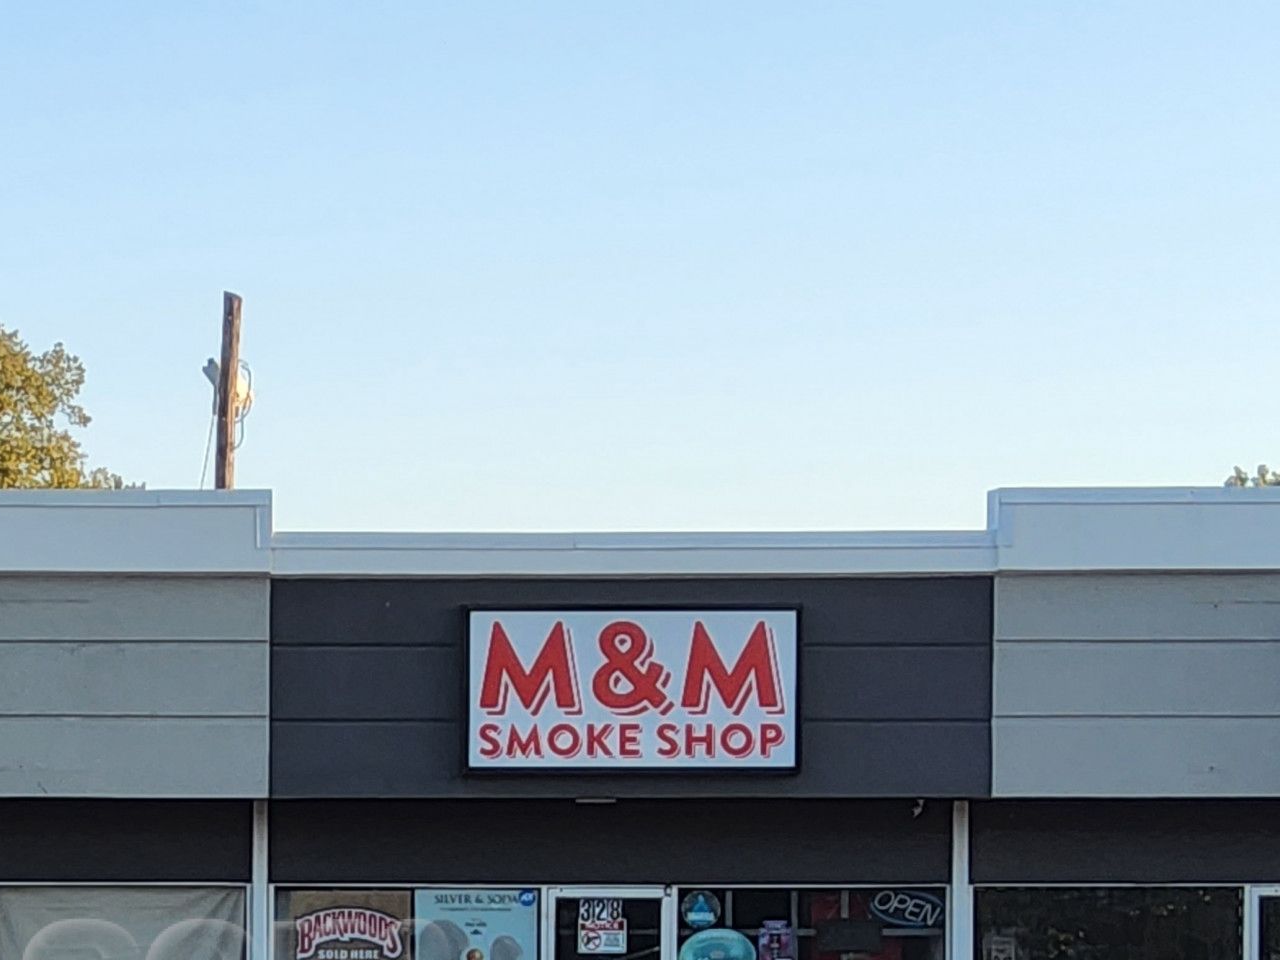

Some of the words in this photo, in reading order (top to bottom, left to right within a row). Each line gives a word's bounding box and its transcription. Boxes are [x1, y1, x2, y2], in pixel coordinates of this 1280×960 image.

[479, 620, 786, 716] M&M
[479, 722, 643, 758] SMOKE
[656, 722, 786, 758] SHOP
[433, 893, 472, 904] SILVER
[475, 893, 484, 904] &
[486, 893, 519, 905] SODA
[580, 898, 621, 922] 328
[874, 890, 941, 926] OPEN
[295, 907, 404, 960] BACKWOODS
[317, 949, 348, 960] SOLD
[350, 949, 380, 960] HERE
